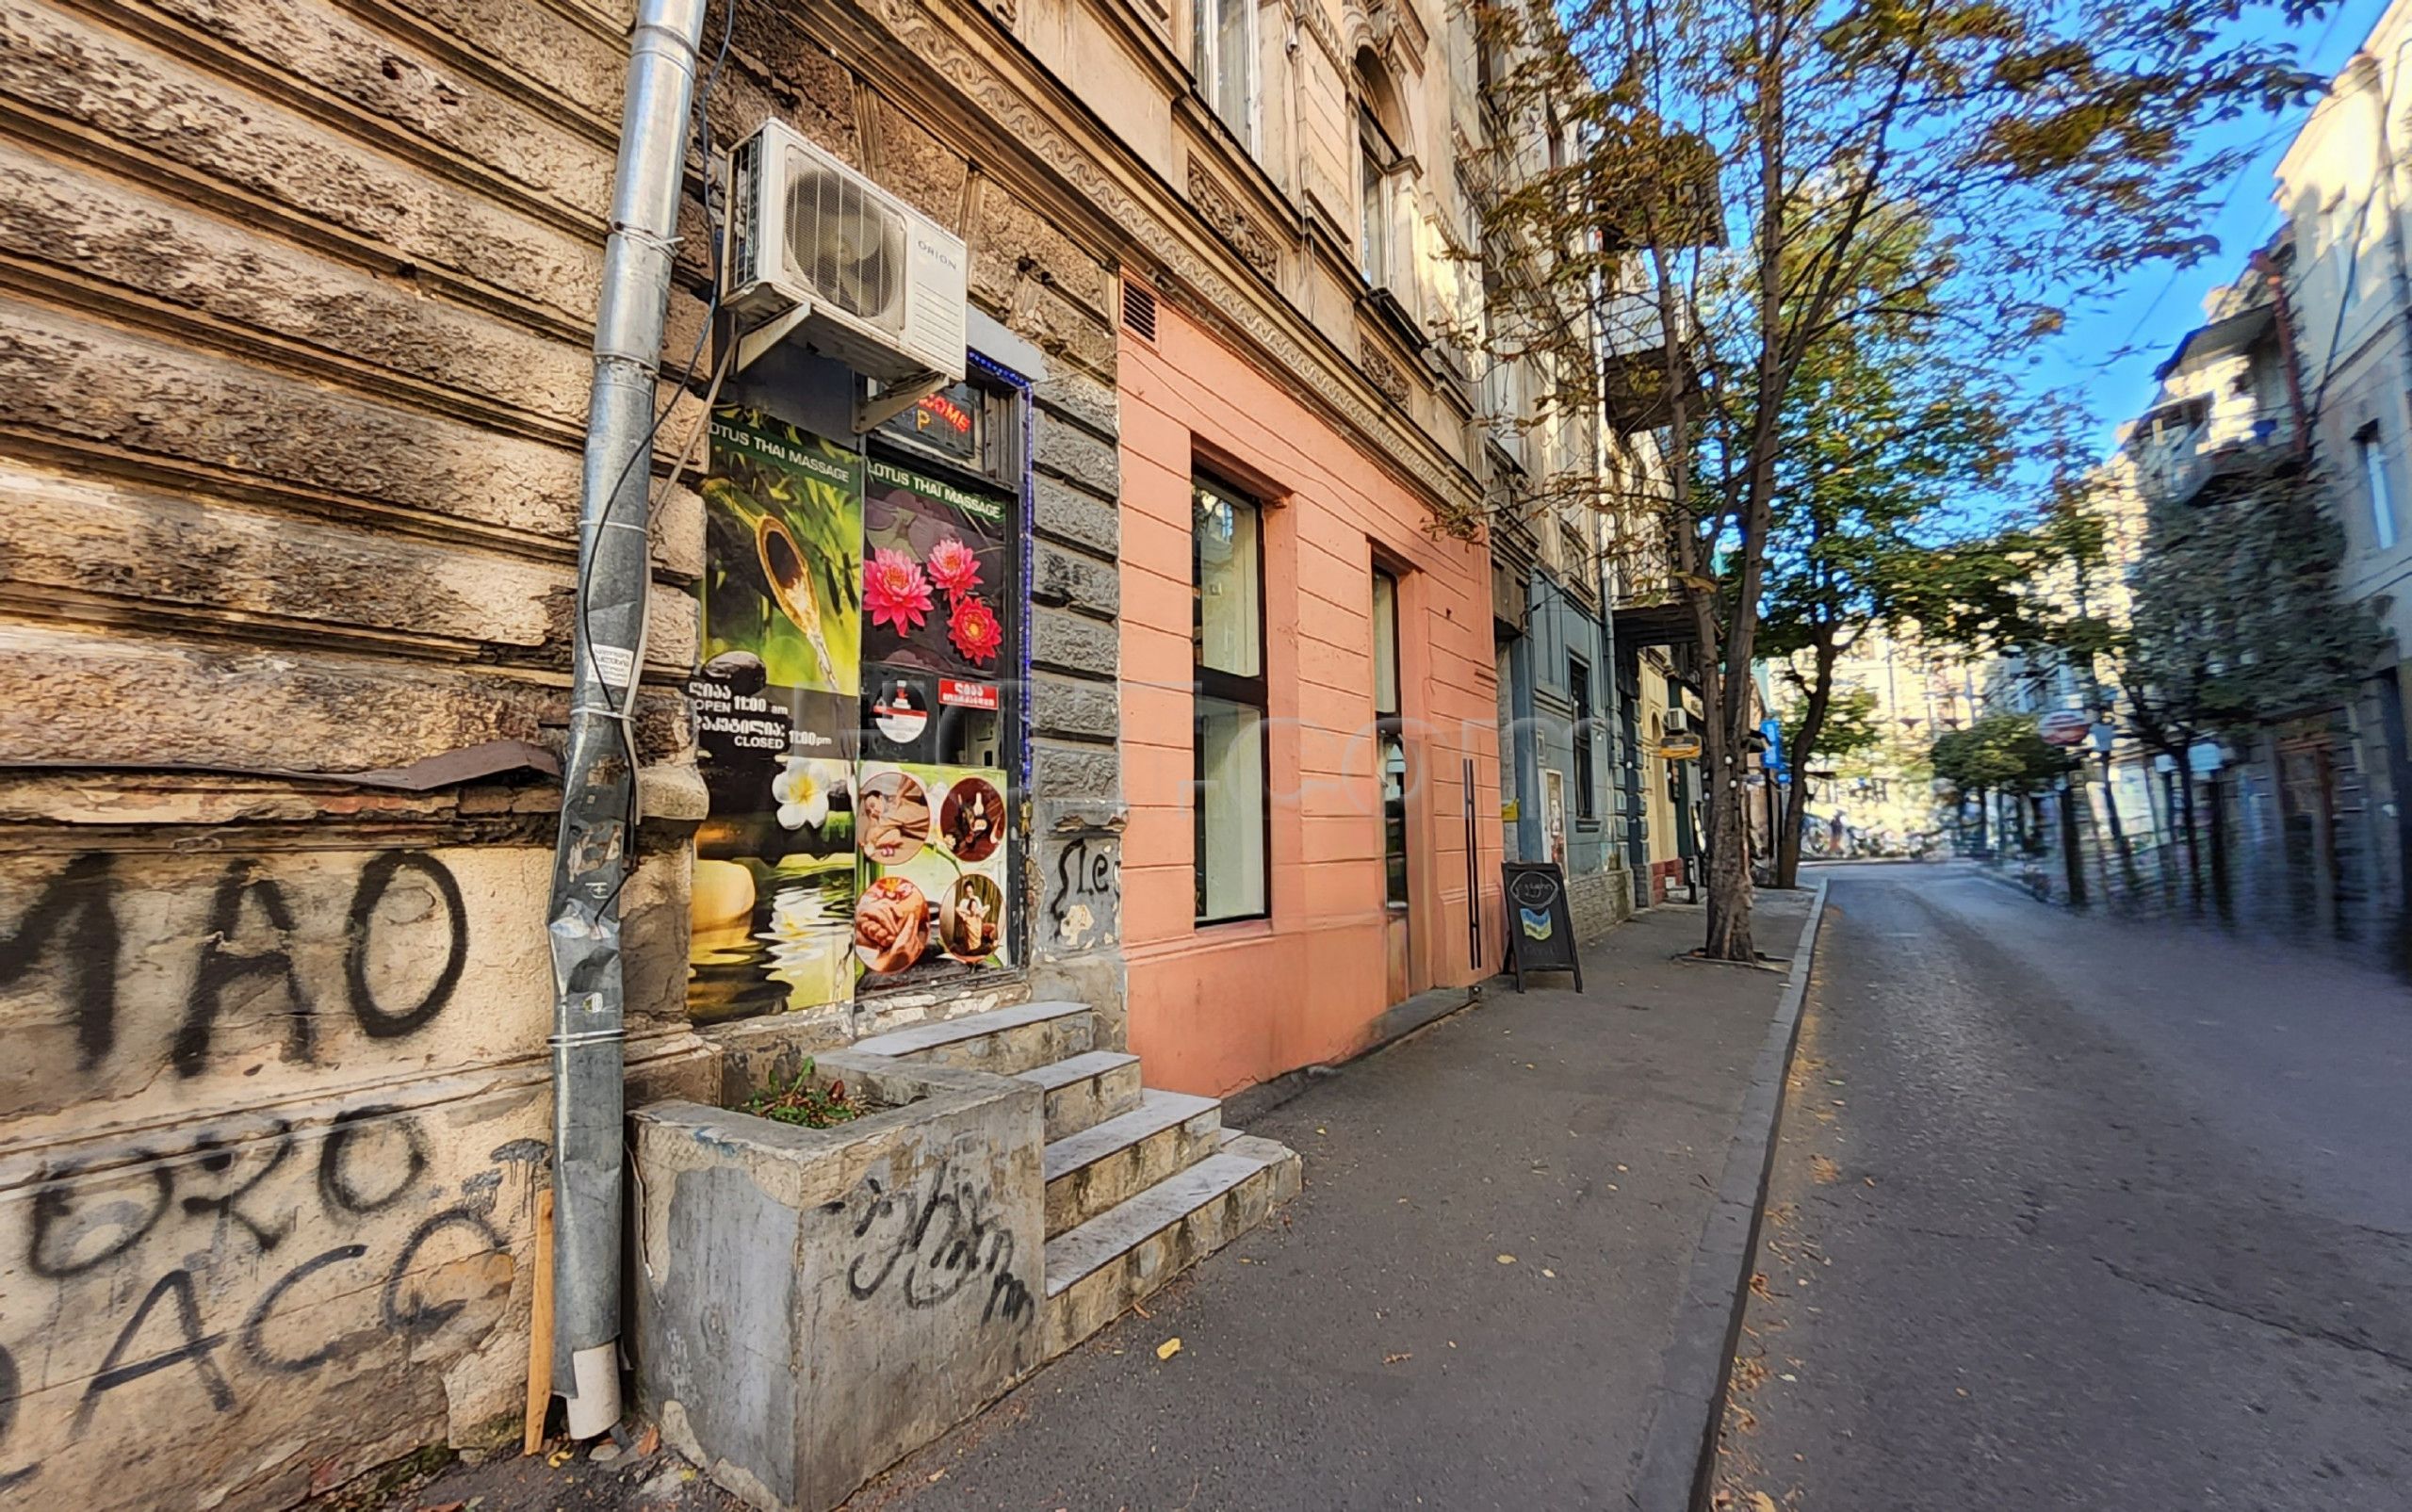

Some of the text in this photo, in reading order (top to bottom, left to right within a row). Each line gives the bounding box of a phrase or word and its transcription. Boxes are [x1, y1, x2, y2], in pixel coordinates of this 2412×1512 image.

[917, 240, 957, 271] ORION
[708, 421, 850, 483] OTUS THAI MASSAGE
[867, 460, 1001, 519] LOTUS THAI MASSAGE
[693, 695, 789, 715] OPEN 11:00 am
[734, 736, 785, 750] CLOSED
